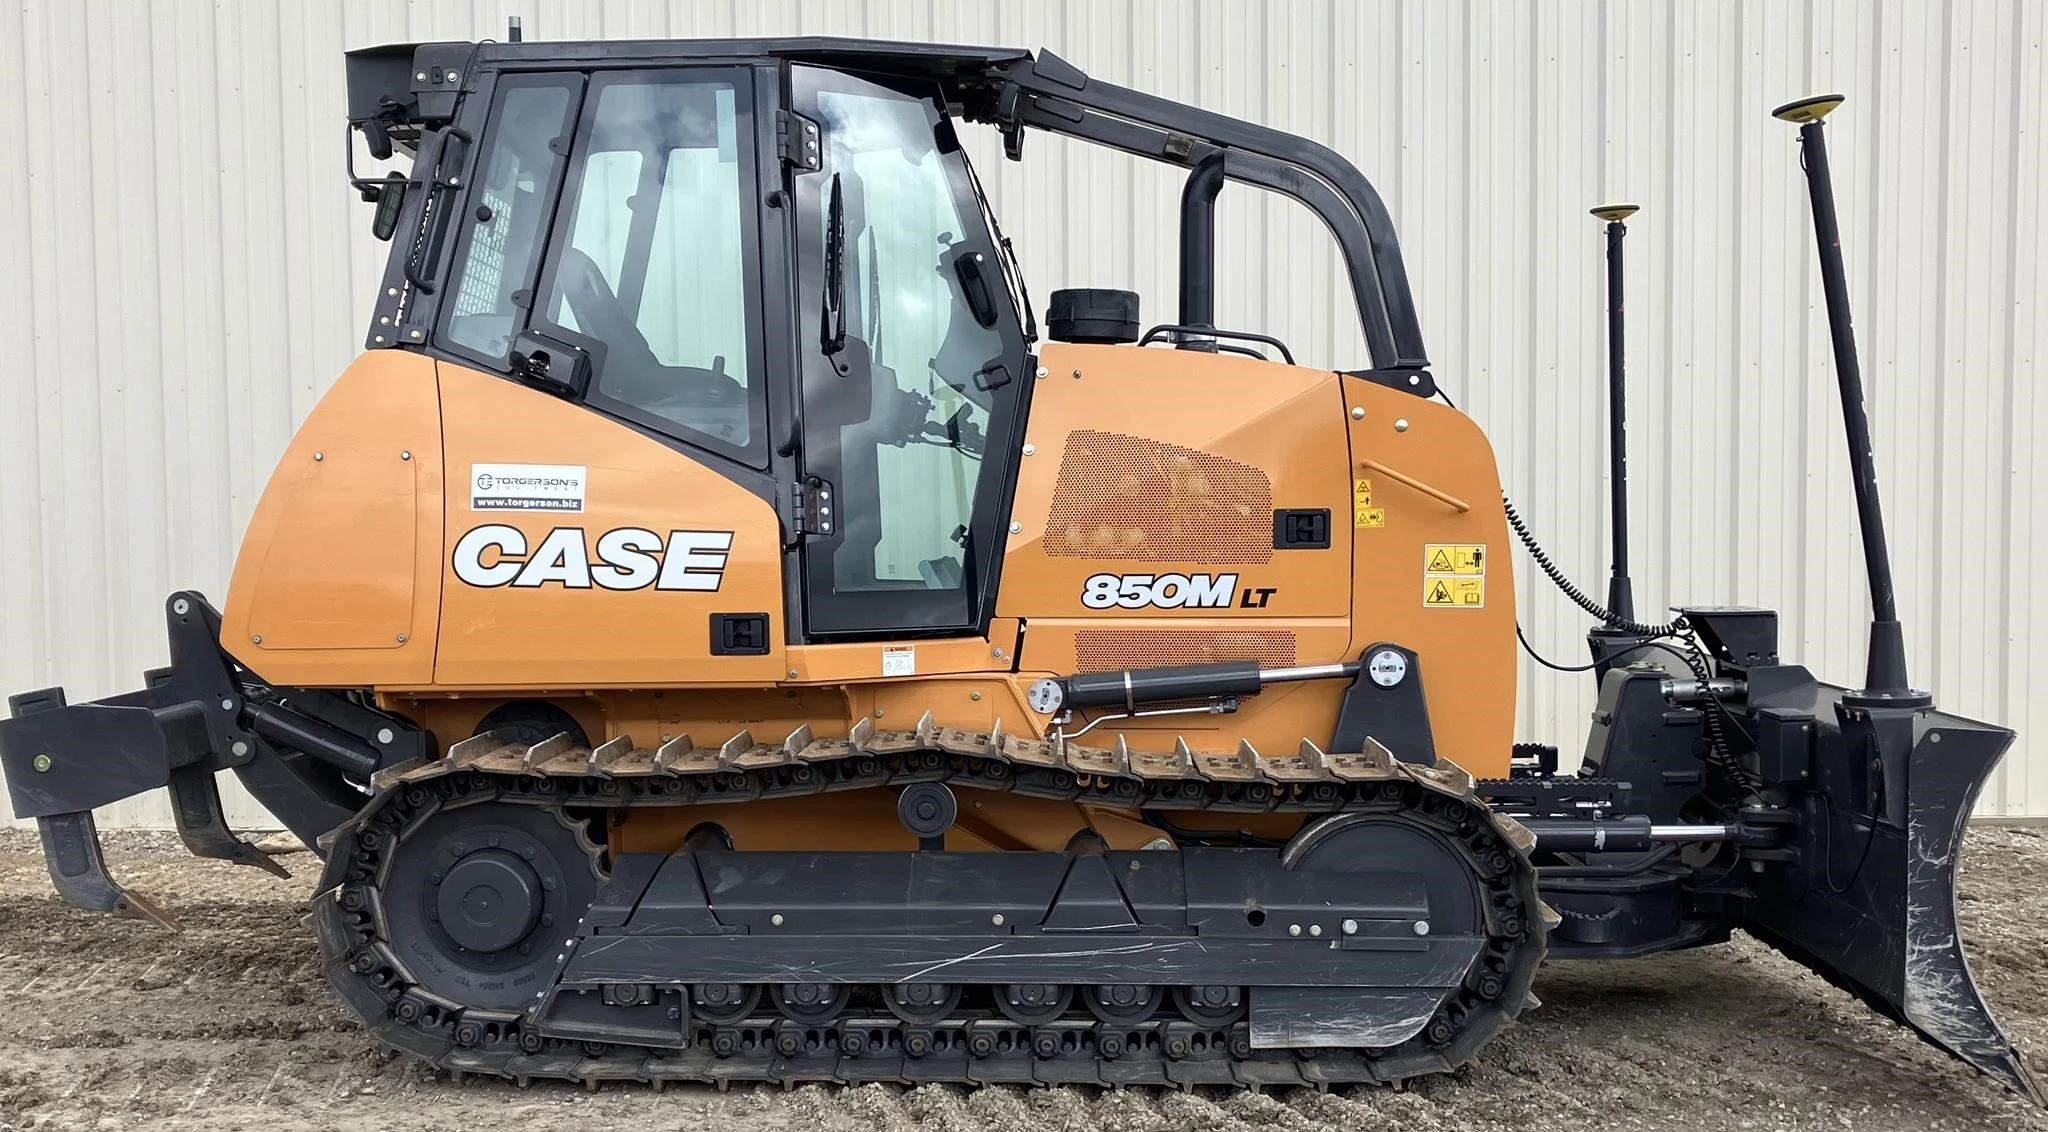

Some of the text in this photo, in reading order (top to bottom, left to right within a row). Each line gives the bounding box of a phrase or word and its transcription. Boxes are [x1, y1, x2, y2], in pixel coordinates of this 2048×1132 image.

[477, 498, 578, 508] www.torgerson.biz
[452, 523, 735, 592] CASE
[1081, 572, 1277, 610] 850M LT
